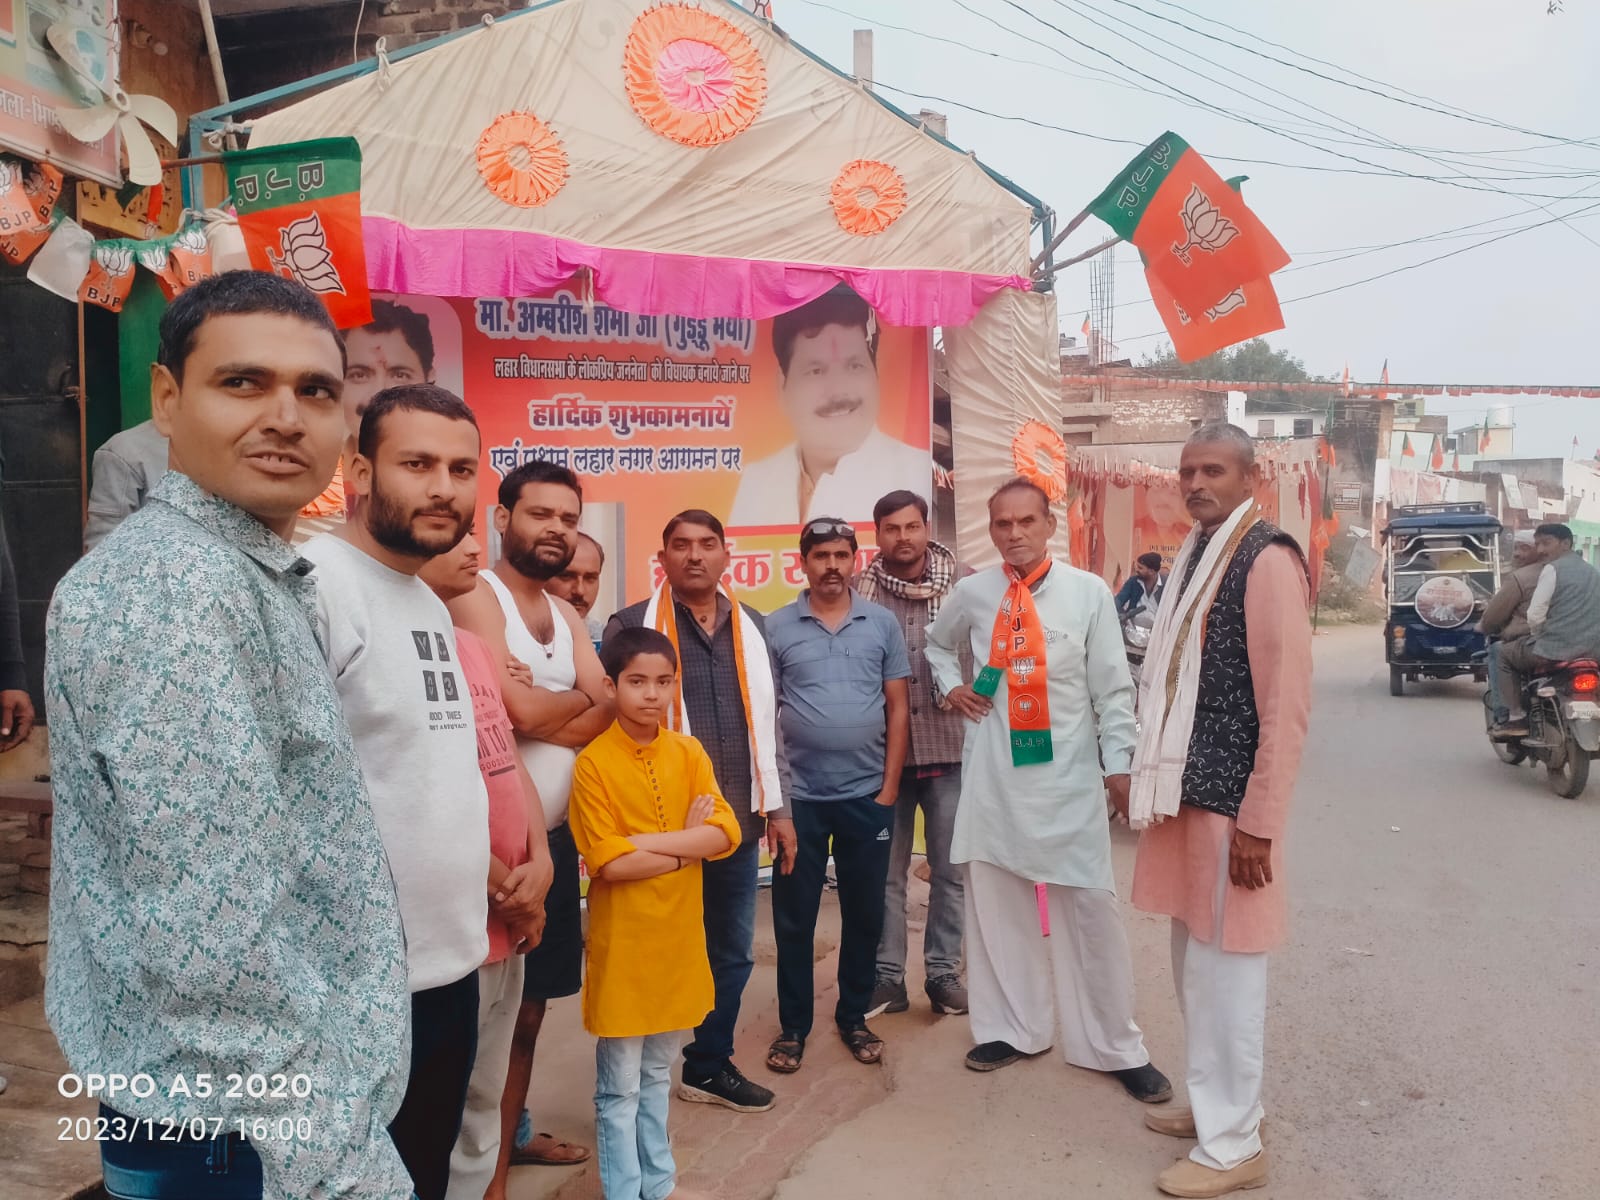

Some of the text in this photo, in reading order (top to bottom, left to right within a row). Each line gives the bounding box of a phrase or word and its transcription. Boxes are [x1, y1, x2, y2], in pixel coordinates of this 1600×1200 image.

[0, 210, 32, 231] BJP
[86, 286, 122, 308] BJP
[478, 299, 510, 332] मा.
[516, 293, 589, 336] अम्बरीश
[531, 397, 603, 428] हार्दिक
[573, 448, 616, 474] लहार
[619, 448, 654, 472] नगर
[657, 448, 718, 472] आगमन
[722, 448, 742, 472] पर
